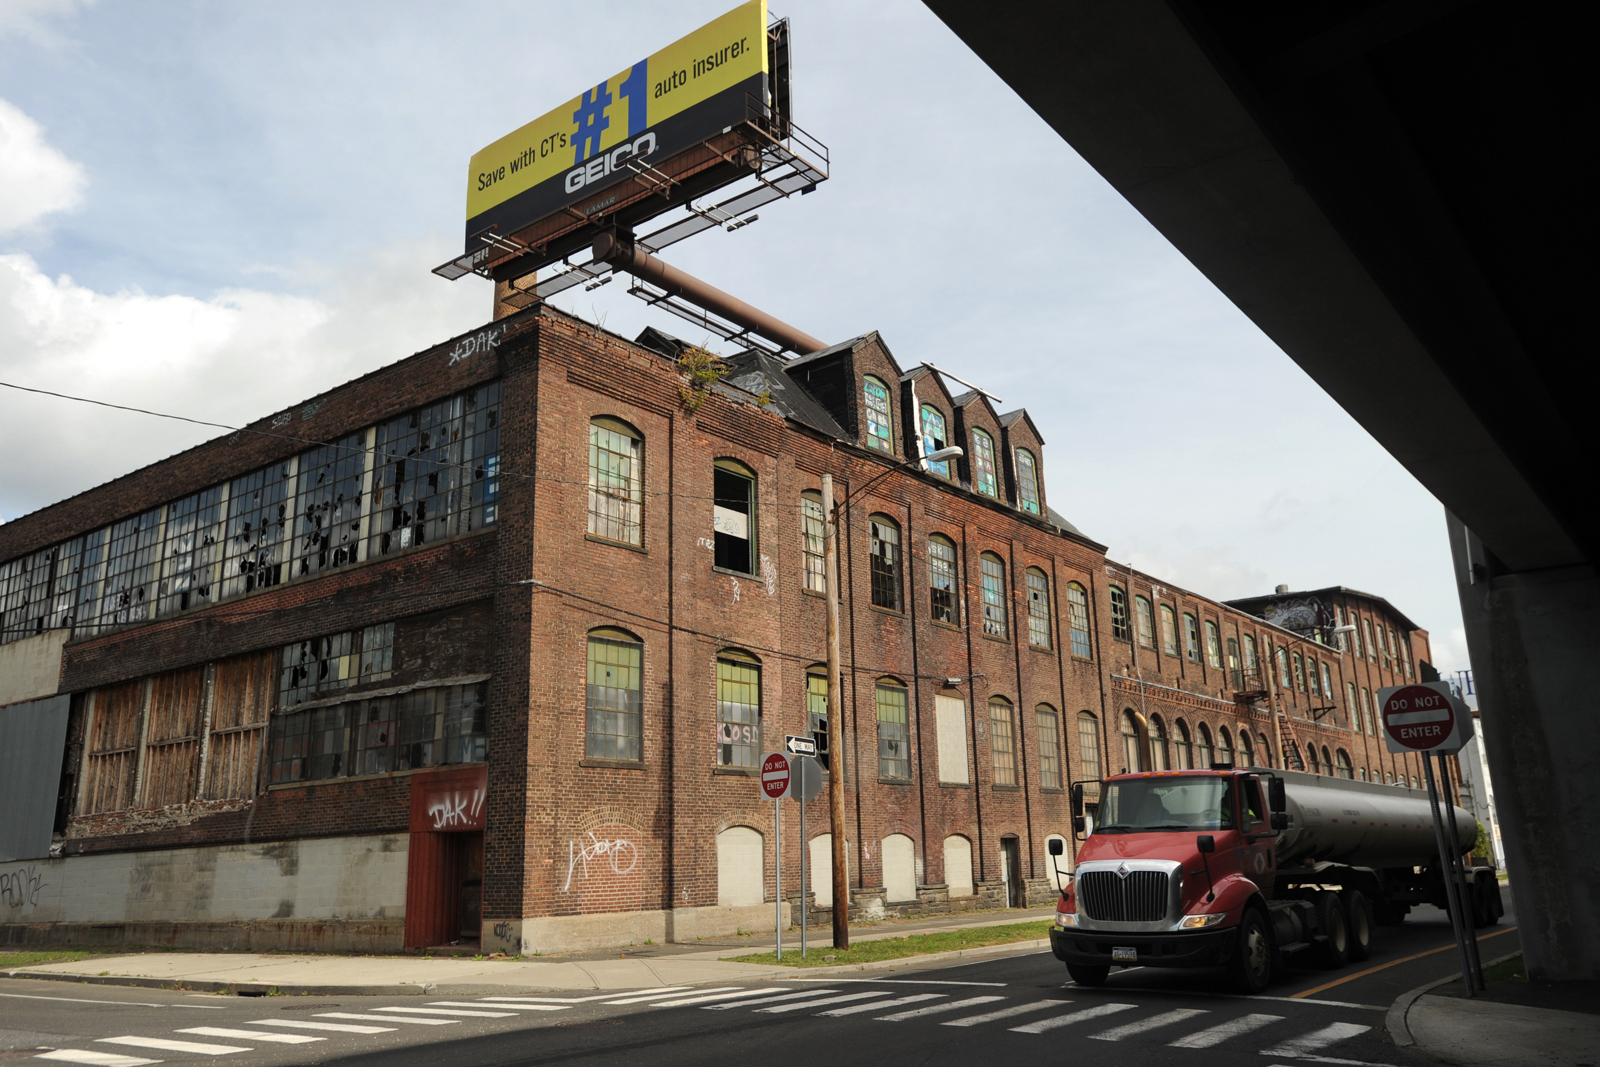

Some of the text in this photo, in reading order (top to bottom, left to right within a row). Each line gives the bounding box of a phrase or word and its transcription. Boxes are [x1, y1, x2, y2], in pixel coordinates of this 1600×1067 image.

[477, 36, 750, 192] Save with CT's #1 auto insurer.
[564, 131, 657, 194] GEICO
[1390, 695, 1440, 711] DO NOT
[1400, 725, 1442, 739] ENTER
[793, 741, 813, 751] ONE WAY
[764, 760, 786, 771] DO NOT
[766, 781, 784, 791] ENTER
